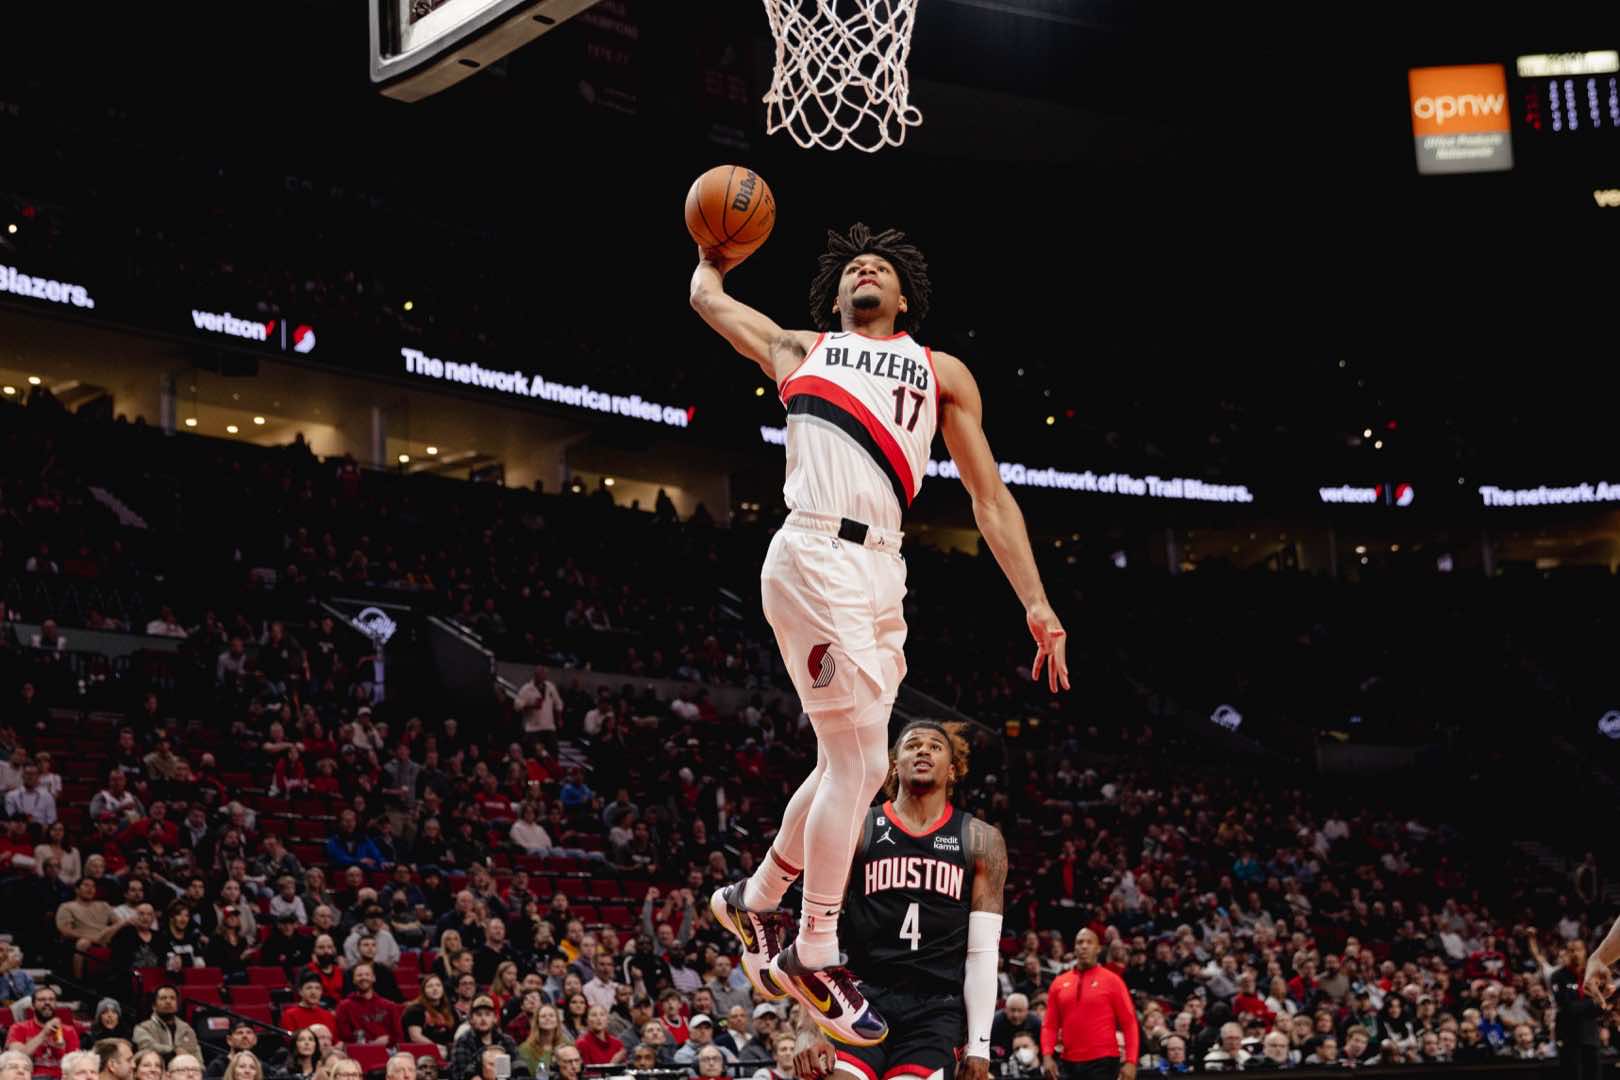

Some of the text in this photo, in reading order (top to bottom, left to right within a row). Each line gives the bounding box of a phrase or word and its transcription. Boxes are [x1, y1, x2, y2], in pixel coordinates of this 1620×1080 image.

[1414, 93, 1504, 126] opnw
[192, 310, 267, 342] verizon
[401, 348, 687, 427] The network America relies on
[892, 386, 925, 432] 17
[1027, 468, 1097, 491] network
[1098, 473, 1116, 493] of
[1117, 474, 1145, 495] the
[1146, 476, 1183, 498] Trail
[1320, 485, 1376, 502] verizon
[1479, 486, 1515, 506] The
[1515, 483, 1594, 505] network
[876, 816, 886, 826] 6
[933, 842, 960, 851] karma
[935, 836, 958, 844] credit
[864, 856, 964, 901] HOUSTON
[899, 903, 922, 951] 4
